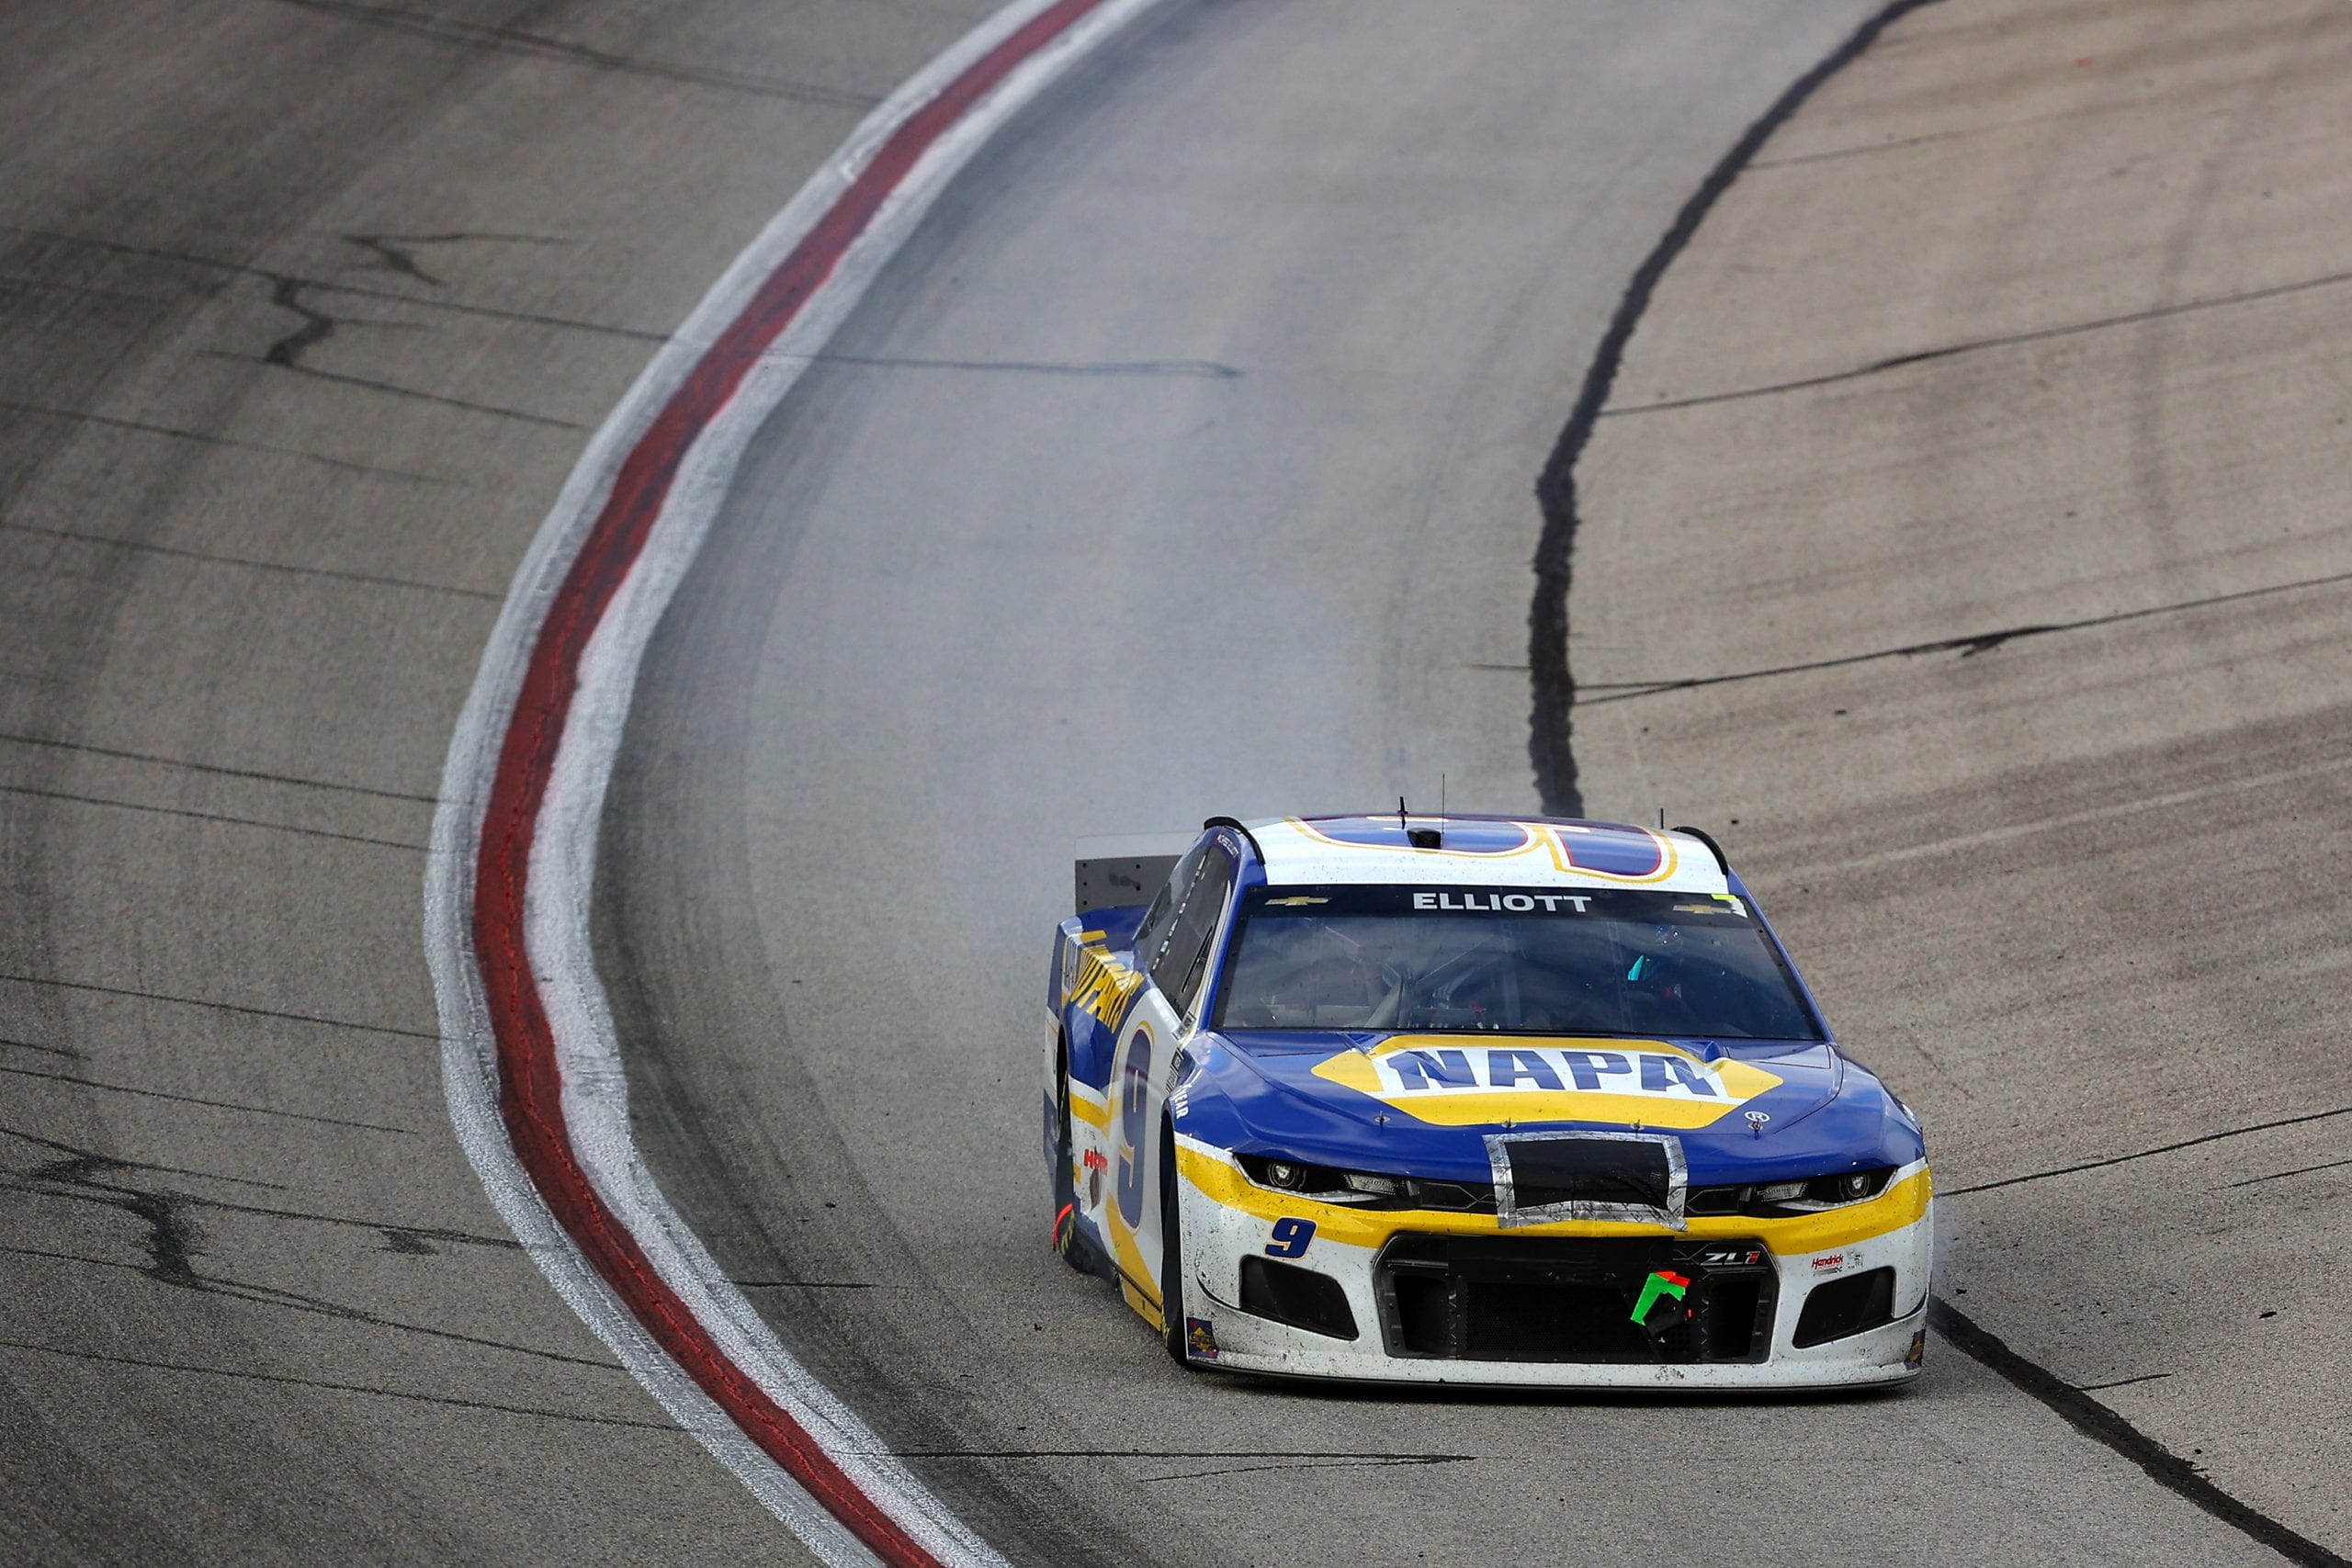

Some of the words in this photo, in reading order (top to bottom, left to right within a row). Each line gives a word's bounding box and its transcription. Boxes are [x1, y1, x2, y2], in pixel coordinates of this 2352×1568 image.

[1412, 892, 1592, 913] ELLIOTT
[1386, 1049, 1717, 1097] NAPA
[1116, 1023, 1153, 1232] 9
[1263, 1216, 1317, 1260] 9
[1700, 1250, 1761, 1266] ZL1
